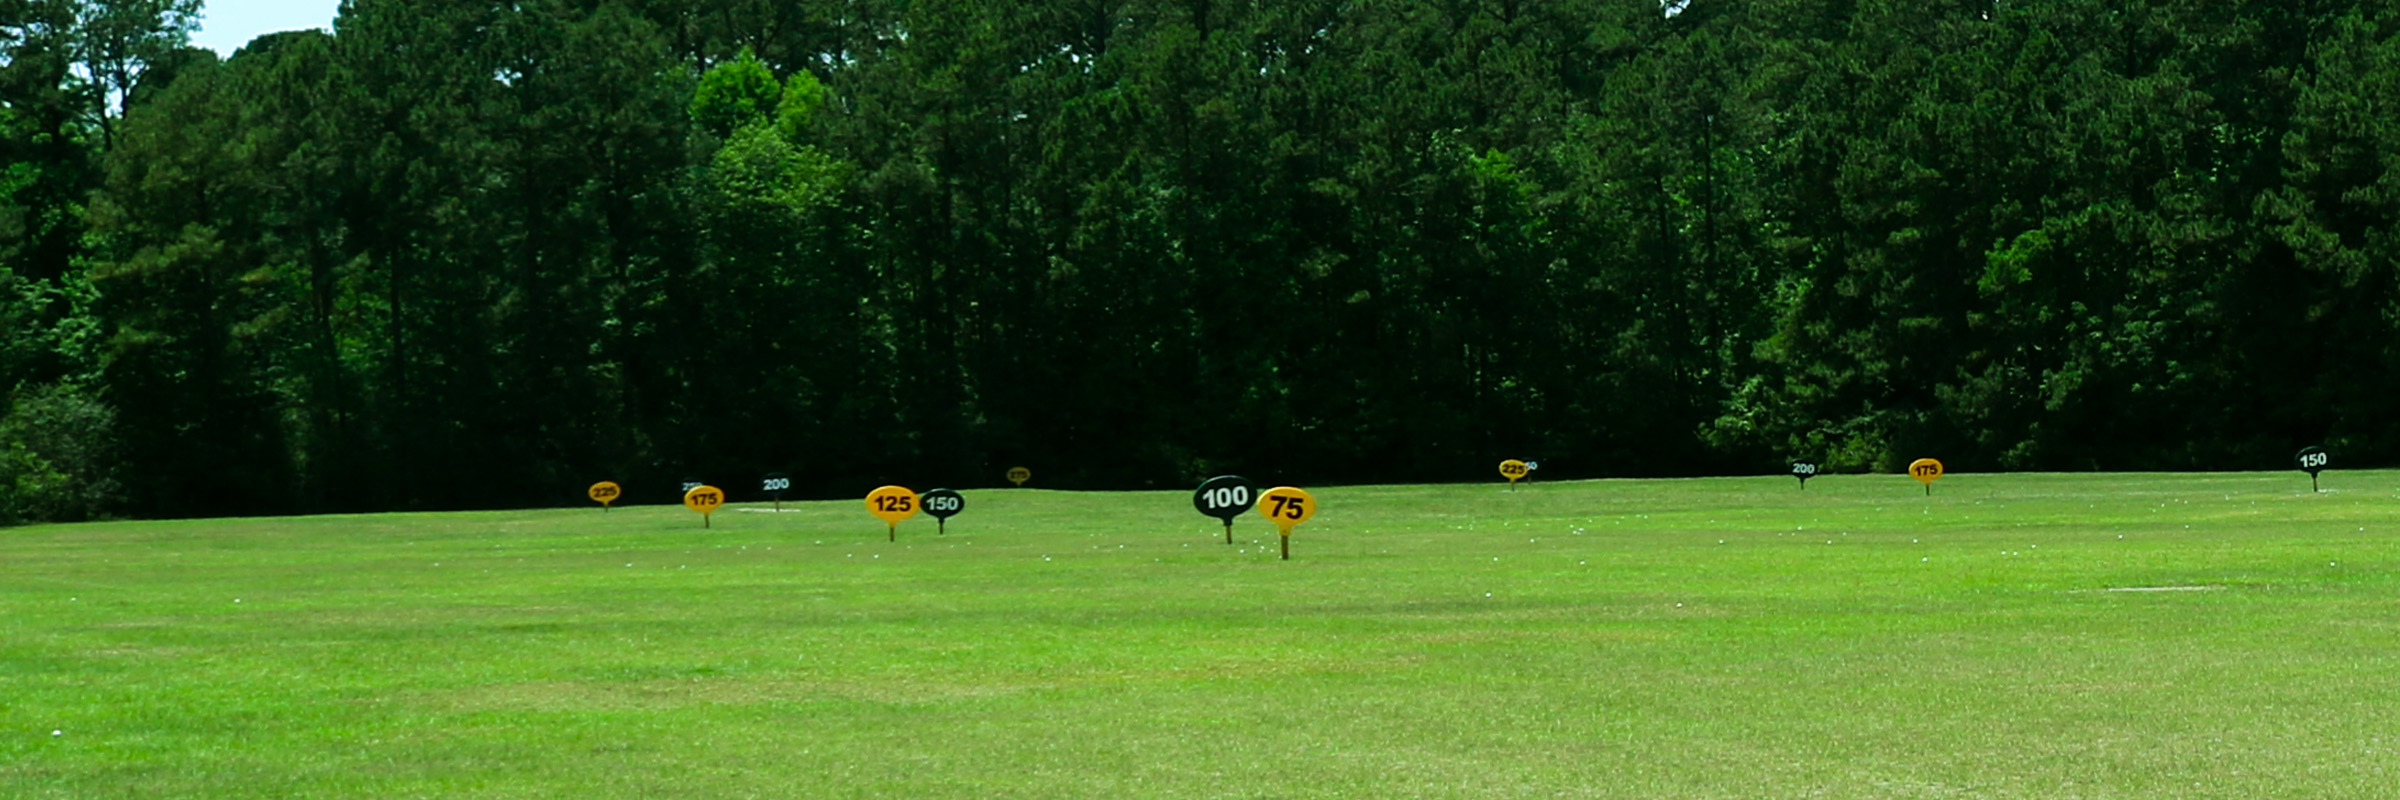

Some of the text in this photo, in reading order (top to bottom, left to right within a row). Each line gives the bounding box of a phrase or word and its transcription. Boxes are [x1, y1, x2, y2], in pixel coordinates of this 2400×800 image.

[2300, 452, 2327, 467] 150
[1502, 464, 1525, 474] 225
[1792, 462, 1815, 474] 200
[1915, 464, 1938, 476] 175
[763, 478, 789, 490] 200
[593, 487, 617, 497] 225
[1202, 485, 1249, 509] 100
[691, 493, 717, 505] 175
[875, 496, 911, 511] 125
[926, 497, 959, 510] 150
[1270, 495, 1304, 519] 75
